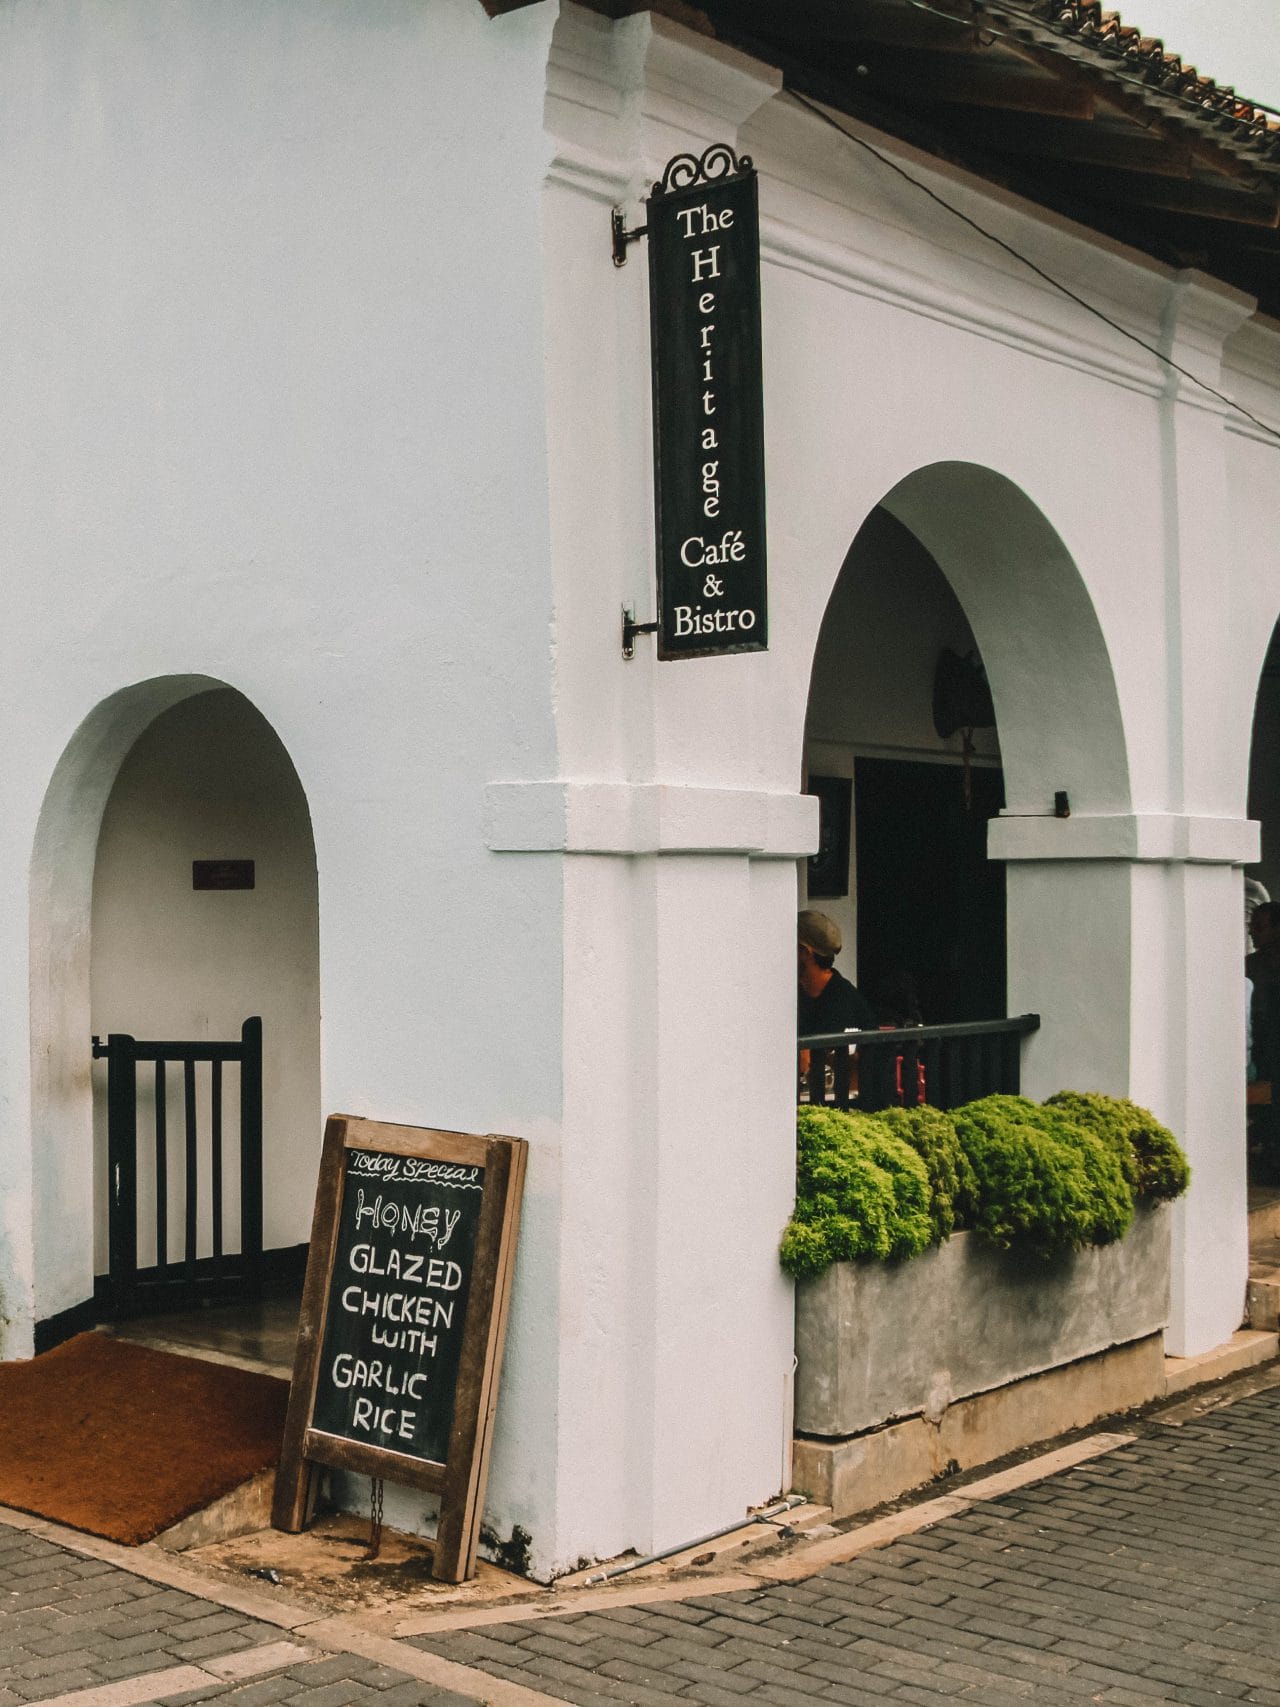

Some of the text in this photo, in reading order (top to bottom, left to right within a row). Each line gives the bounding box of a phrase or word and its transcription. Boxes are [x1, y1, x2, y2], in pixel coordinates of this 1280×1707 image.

[676, 203, 734, 238] The
[690, 245, 721, 518] Heritage
[680, 530, 746, 567] Café
[703, 574, 724, 597] &
[674, 605, 756, 636] Bistro
[351, 1150, 478, 1182] Today Special
[355, 1188, 461, 1250] HONEY
[349, 1243, 462, 1291] GLAZED
[341, 1286, 455, 1329] CHICKEN
[371, 1322, 438, 1357] WITH
[331, 1353, 428, 1400] GARLIC
[352, 1397, 417, 1439] RICE
